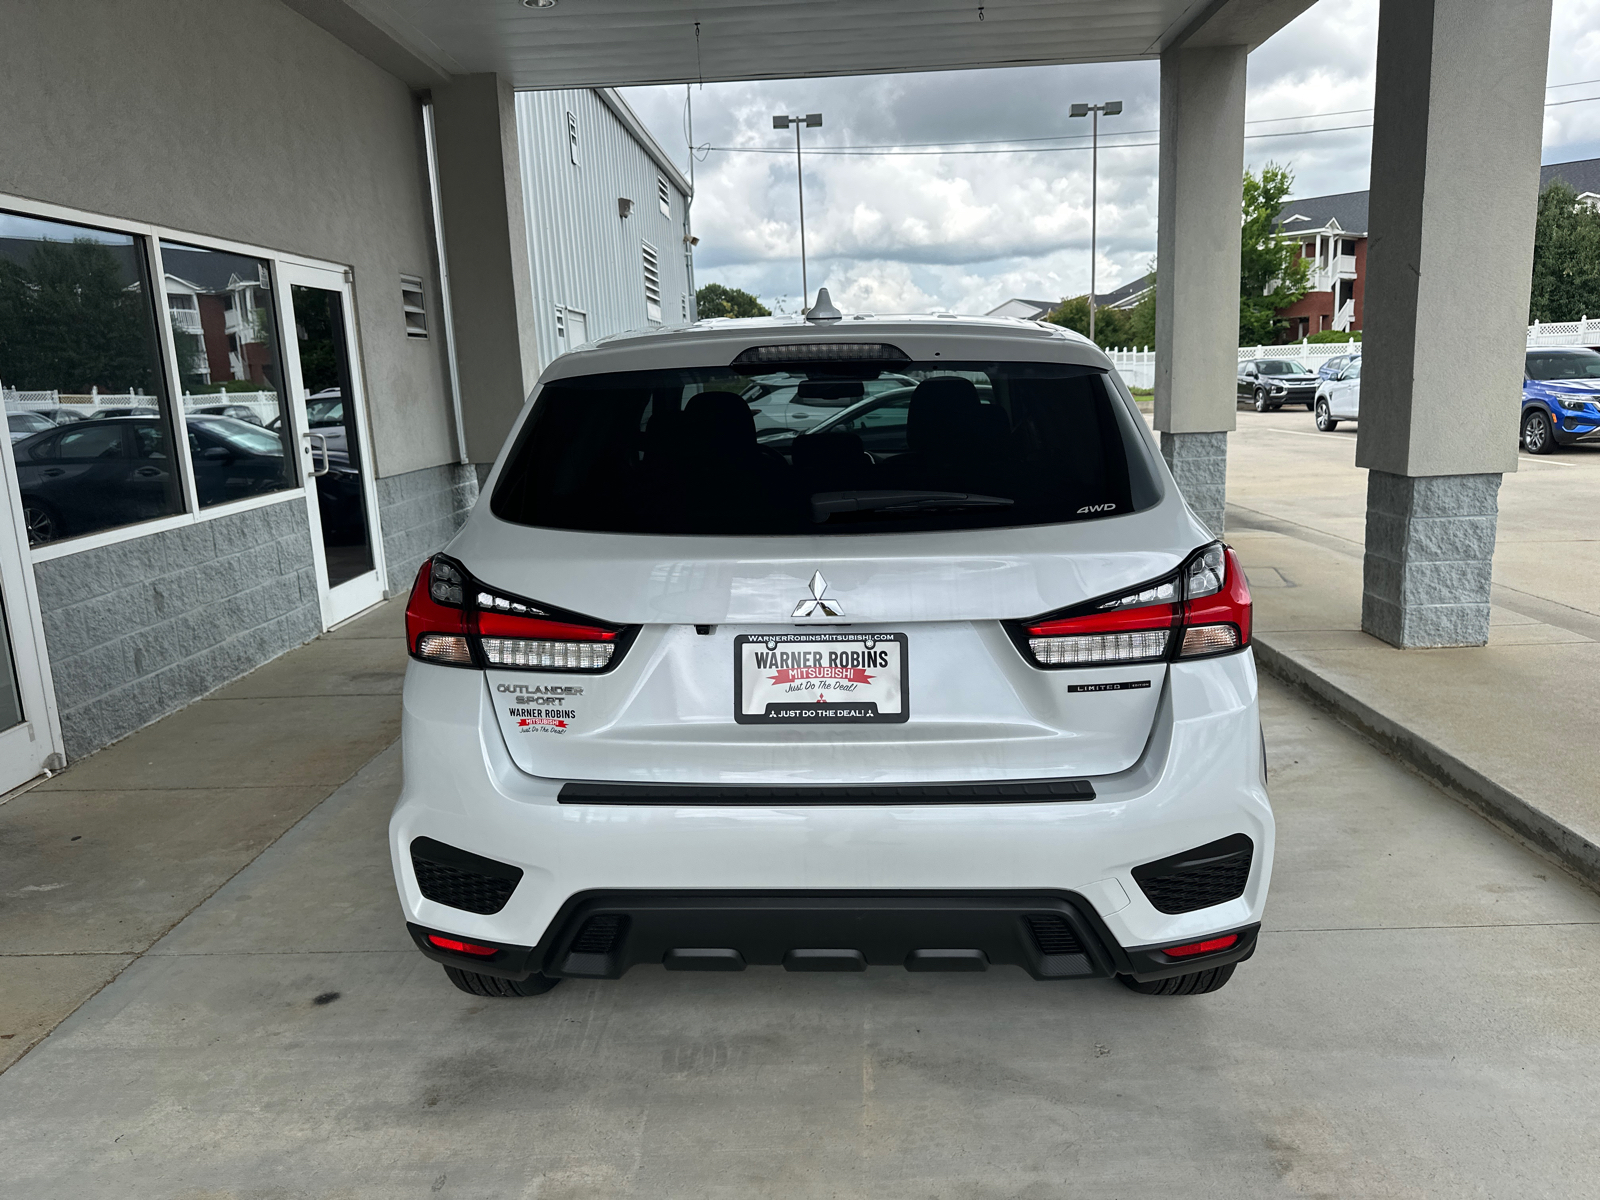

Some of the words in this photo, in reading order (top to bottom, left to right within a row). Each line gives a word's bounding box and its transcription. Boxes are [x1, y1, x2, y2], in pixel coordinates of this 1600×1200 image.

[1076, 503, 1117, 514] 4WD
[754, 651, 823, 669] WARNER
[829, 650, 889, 668] ROBINS
[788, 668, 854, 679] MITSUBISHI
[497, 684, 584, 696] OUTLANDER
[785, 682, 803, 693] Just
[804, 680, 816, 690] Do
[817, 679, 832, 690] The
[833, 681, 858, 692] Deal!
[1077, 684, 1121, 692] LIMITED
[515, 695, 565, 706] SPORT
[509, 708, 543, 718] WARNER
[545, 709, 576, 719] ROBINS
[778, 710, 800, 718] JUST
[801, 709, 816, 717] DO
[817, 709, 836, 717] THE
[837, 709, 865, 718] DEAL!
